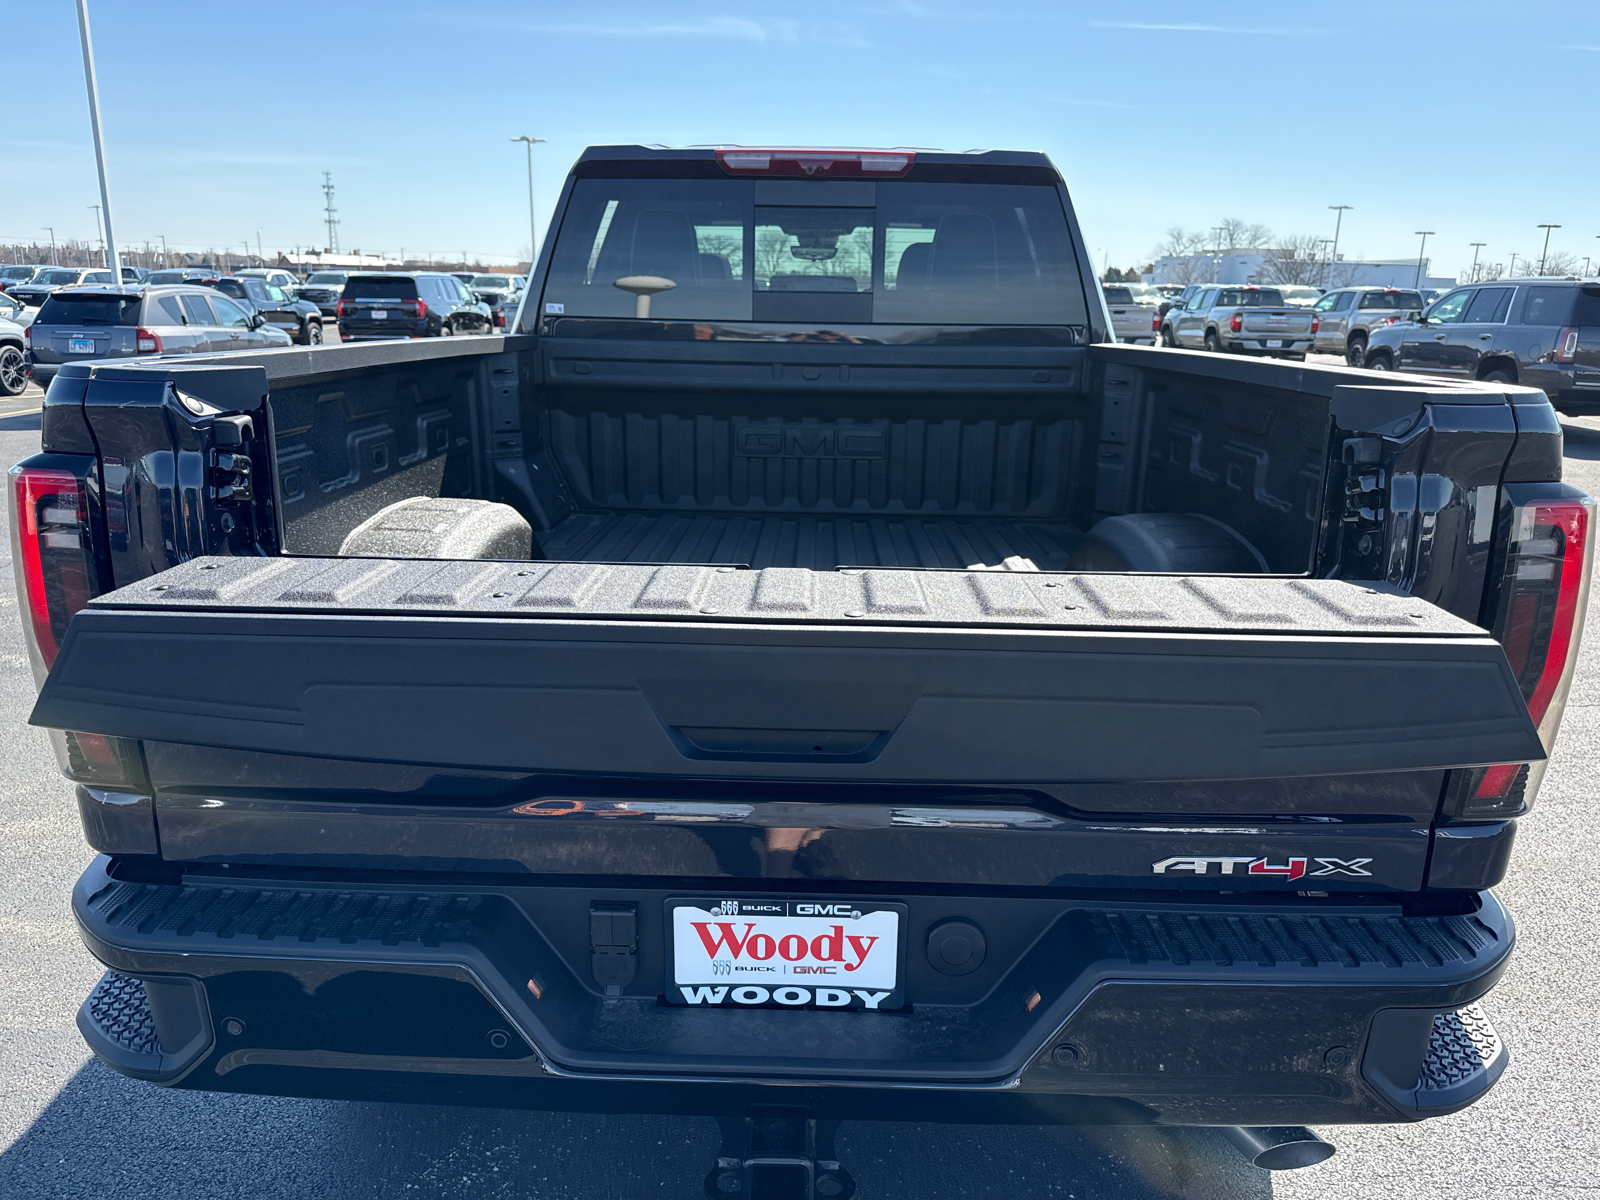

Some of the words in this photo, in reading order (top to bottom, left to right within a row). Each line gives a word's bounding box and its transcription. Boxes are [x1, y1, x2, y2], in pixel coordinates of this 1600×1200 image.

[737, 428, 884, 457] GMC
[1152, 856, 1373, 882] AT4X
[796, 904, 851, 916] GMC
[690, 922, 879, 972] Woody
[793, 966, 837, 975] GMC
[680, 986, 891, 1009] WOODY
